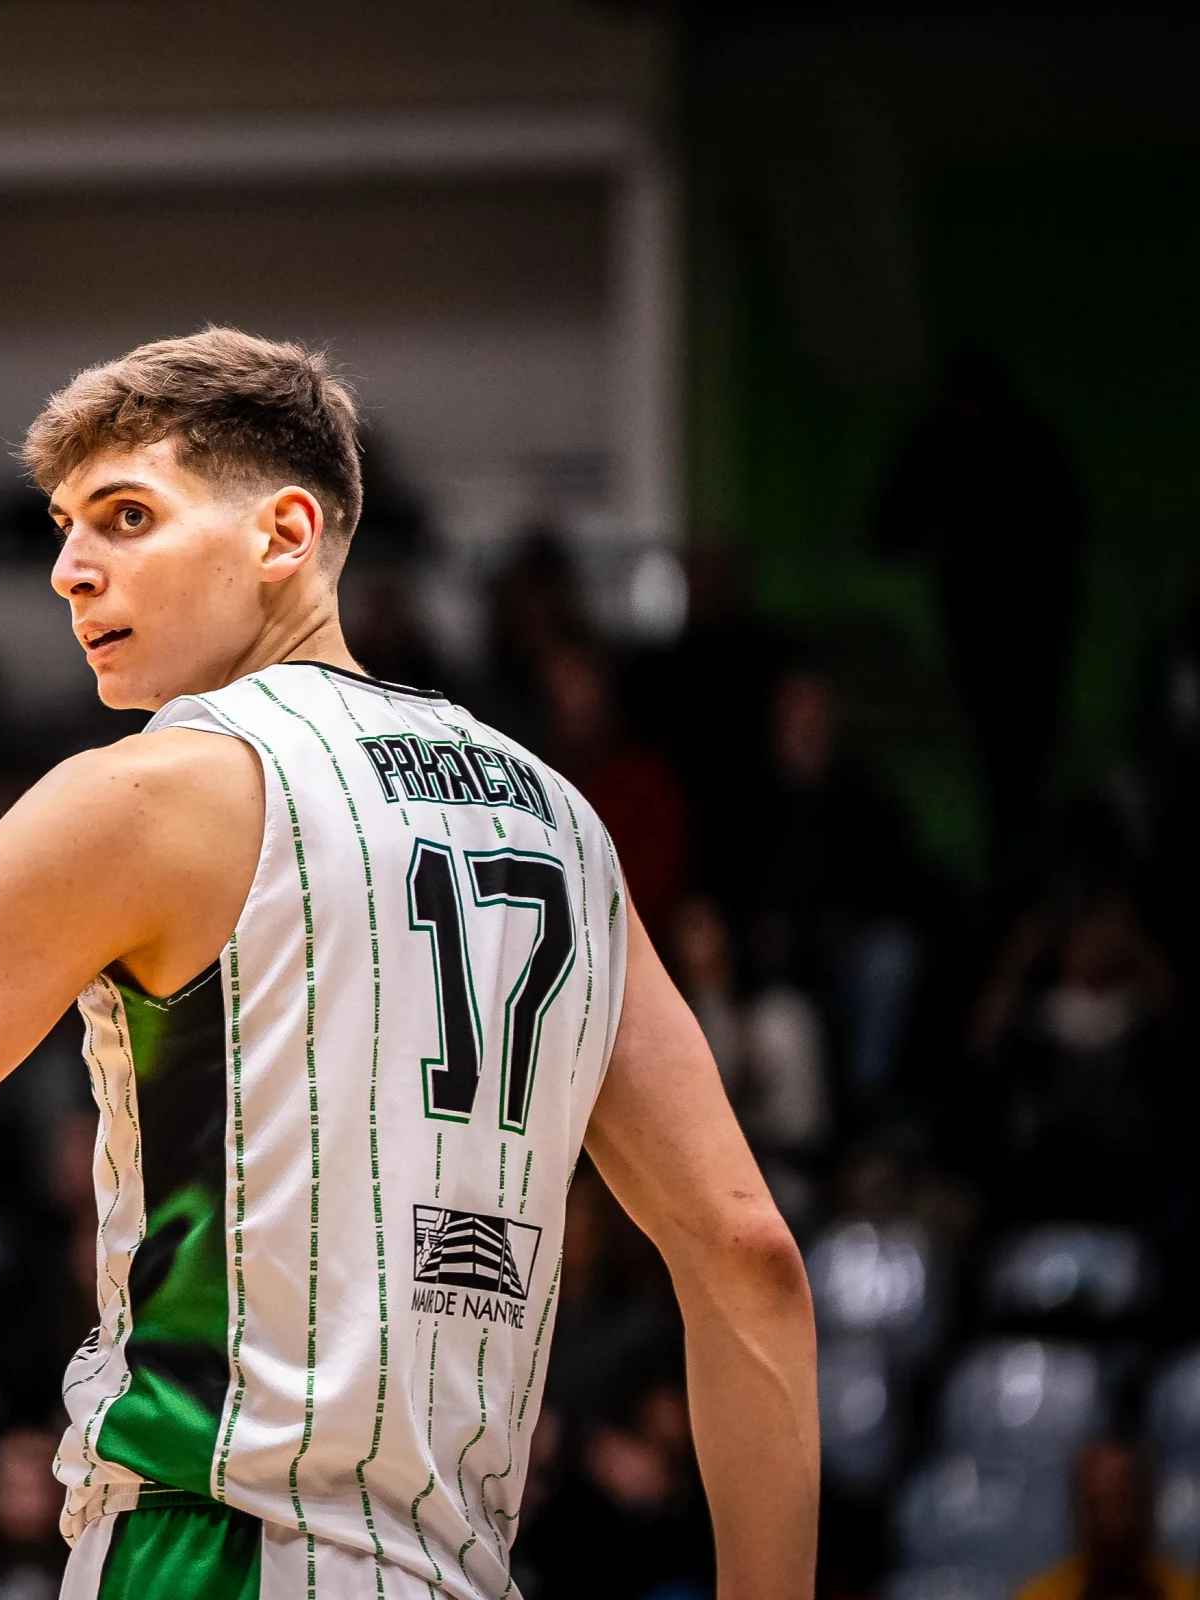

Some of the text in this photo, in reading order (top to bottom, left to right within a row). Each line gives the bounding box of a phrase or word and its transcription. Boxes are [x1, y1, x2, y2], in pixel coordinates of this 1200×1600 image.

[286, 798, 299, 824] BACK
[292, 825, 301, 837] IS
[294, 840, 309, 890] NANTERRE
[358, 836, 372, 887] NANTERRE
[302, 892, 313, 934] EUROPE,
[230, 951, 239, 978] BACK
[305, 942, 314, 969] BACK
[371, 938, 379, 965] BACK
[231, 980, 240, 992] IS
[306, 971, 315, 982] IS
[373, 967, 380, 978] IS
[406, 837, 576, 1136] 17
[231, 994, 240, 1044] NANTERRE
[306, 984, 315, 1035] NANTERRE
[306, 1037, 316, 1079] EUROPE,
[234, 1091, 242, 1118] BACK
[309, 1086, 318, 1112] BACK
[234, 1120, 243, 1131] IS
[310, 1114, 319, 1125] IS
[369, 1114, 376, 1125] IS
[235, 1133, 244, 1181] NANTERRE
[311, 1128, 320, 1179] NANTERRE
[370, 1128, 380, 1179] NANTERRE
[311, 1182, 320, 1223] EUROPE,
[372, 1182, 383, 1223] EUROPE,
[234, 1229, 243, 1254] BACK
[310, 1231, 318, 1258] BACK
[376, 1231, 385, 1257] BACK
[234, 1256, 242, 1267] IS
[310, 1260, 318, 1272] IS
[377, 1259, 386, 1270] IS
[236, 1269, 245, 1316] NANTERRE
[308, 1274, 318, 1325] NANTERRE
[378, 1272, 388, 1322] NANTERRE
[307, 1328, 317, 1369] EUROPE,
[380, 1324, 389, 1366] EUROPE,
[233, 1390, 244, 1401] IS
[306, 1375, 315, 1396] BACK
[377, 1374, 387, 1400] BACK
[305, 1398, 314, 1409] IS
[376, 1402, 385, 1413] IS
[223, 1402, 241, 1447] NANTERRE
[291, 1495, 305, 1519] BACK
[307, 1560, 316, 1586] BACK
